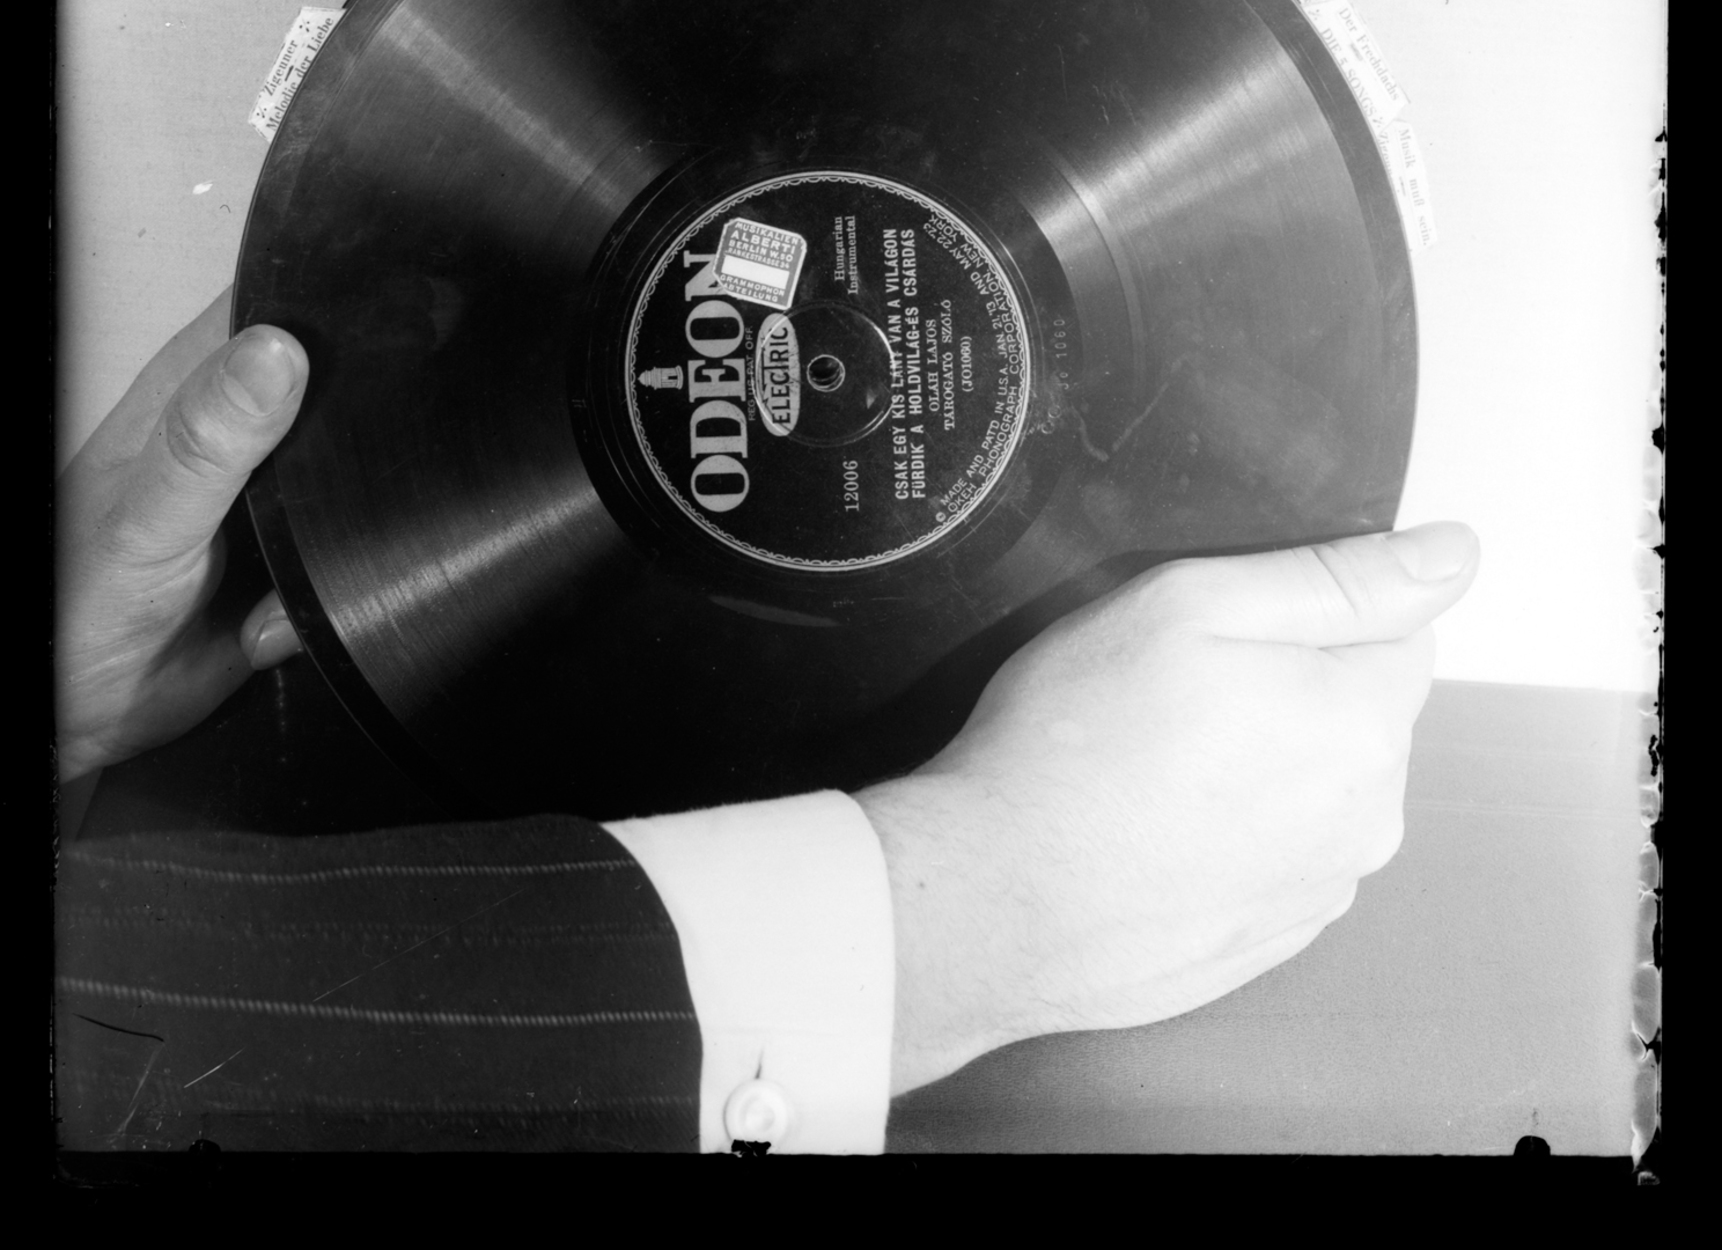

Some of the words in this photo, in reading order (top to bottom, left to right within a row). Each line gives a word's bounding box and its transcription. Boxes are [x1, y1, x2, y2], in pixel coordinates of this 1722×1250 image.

[264, 38, 299, 97] Zigeuner
[1338, 6, 1358, 34] Der
[1356, 34, 1400, 102] Frechdachs
[265, 83, 298, 132] Melodie
[295, 54, 312, 79] der
[306, 16, 334, 52] Liebe
[1320, 27, 1342, 54] DIE
[1346, 68, 1376, 118] SONGS
[1398, 128, 1418, 169] Musik
[1408, 178, 1426, 207] muß
[1418, 214, 1432, 246] sein.
[730, 230, 796, 254] ALBERTI
[735, 222, 799, 244] MUSIKALIEN
[928, 214, 957, 242] YORK
[728, 240, 767, 256] BERLIN
[832, 216, 846, 281] Hungarian
[844, 215, 858, 294] Instrumental
[884, 229, 900, 293] VILÁGON
[900, 229, 917, 296] CSÁRDÁS
[949, 247, 971, 270] MAY
[960, 243, 984, 268] NEW
[720, 274, 785, 296] GRAMMOPHON
[724, 282, 778, 302] ABTEILUNG
[970, 271, 989, 295] AND
[887, 299, 900, 308] A
[888, 315, 902, 343] VAN
[926, 318, 938, 364] LAJOS
[905, 306, 922, 414] HOLDVILÁG-ÉS
[683, 250, 750, 512] ODEON
[762, 328, 790, 424] ELECTRIC
[892, 394, 906, 418] KIS
[994, 400, 1005, 414] IN
[892, 426, 907, 454] EGY
[910, 424, 924, 434] A
[978, 386, 1018, 477] PHONOGRAPH
[894, 460, 909, 500] CSAK
[910, 442, 926, 498] FÜRDIK
[966, 454, 984, 478] AND
[842, 460, 860, 512] 12006
[940, 477, 968, 506] MADE
[947, 482, 977, 512] OKEH
